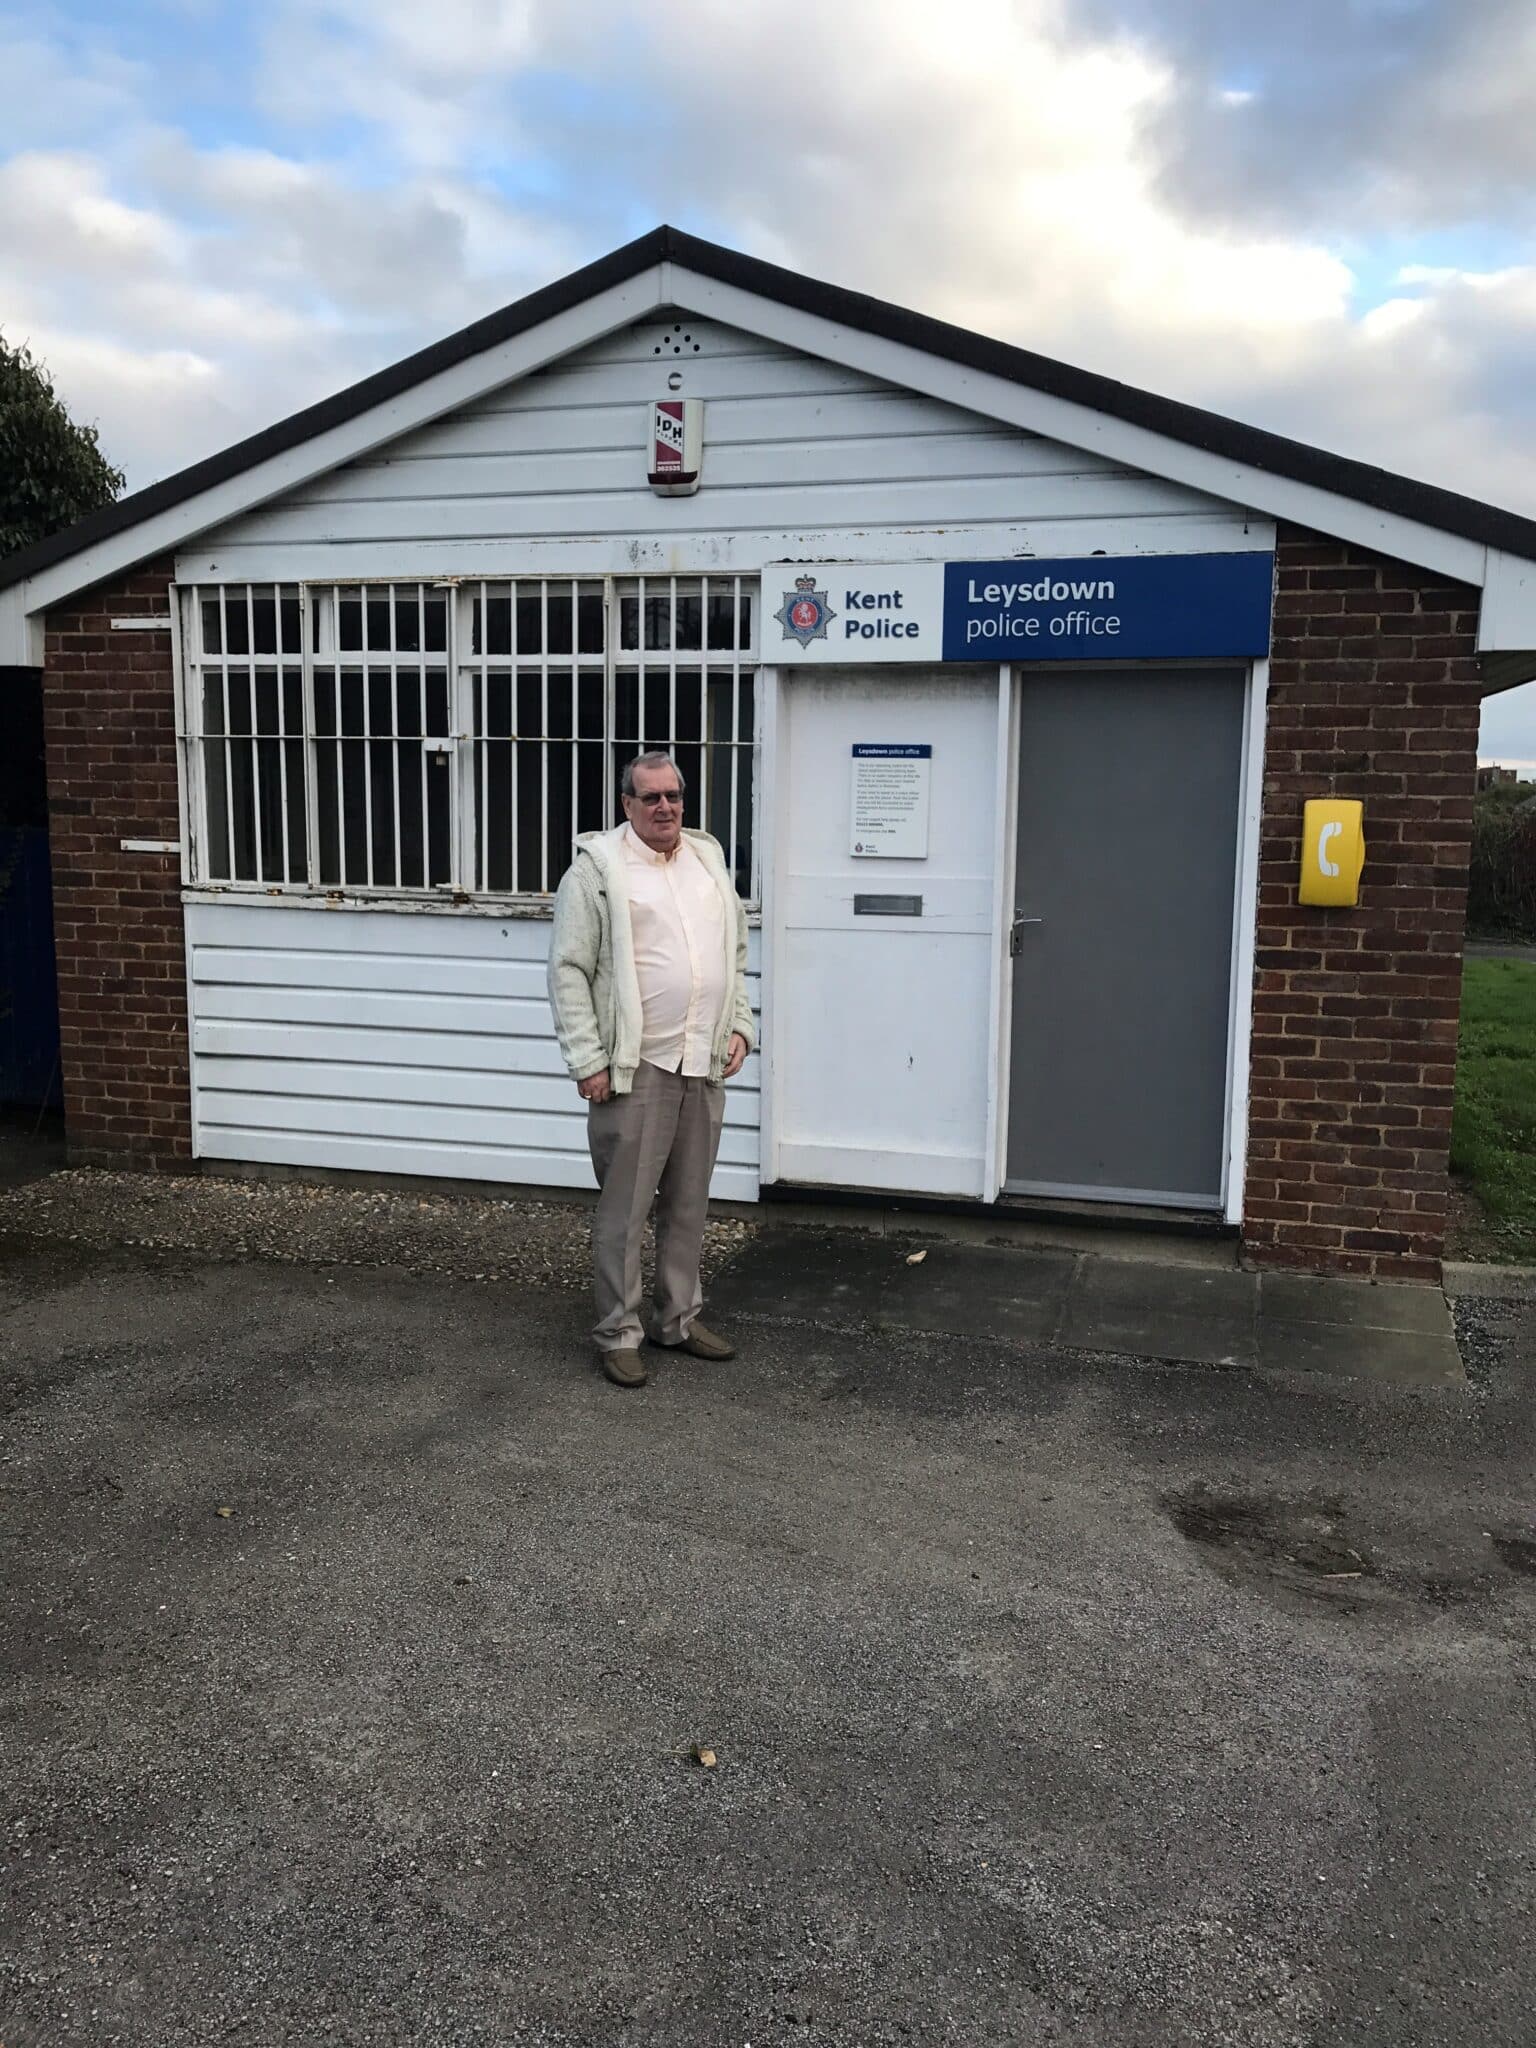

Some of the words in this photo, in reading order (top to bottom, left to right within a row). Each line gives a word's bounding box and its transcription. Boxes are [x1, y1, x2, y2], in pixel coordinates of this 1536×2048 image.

[657, 415, 682, 439] IDH
[845, 590, 903, 610] Kent
[968, 576, 1115, 608] Leysdown
[845, 618, 920, 639] Police
[966, 613, 1040, 643] police
[1049, 611, 1121, 636] office
